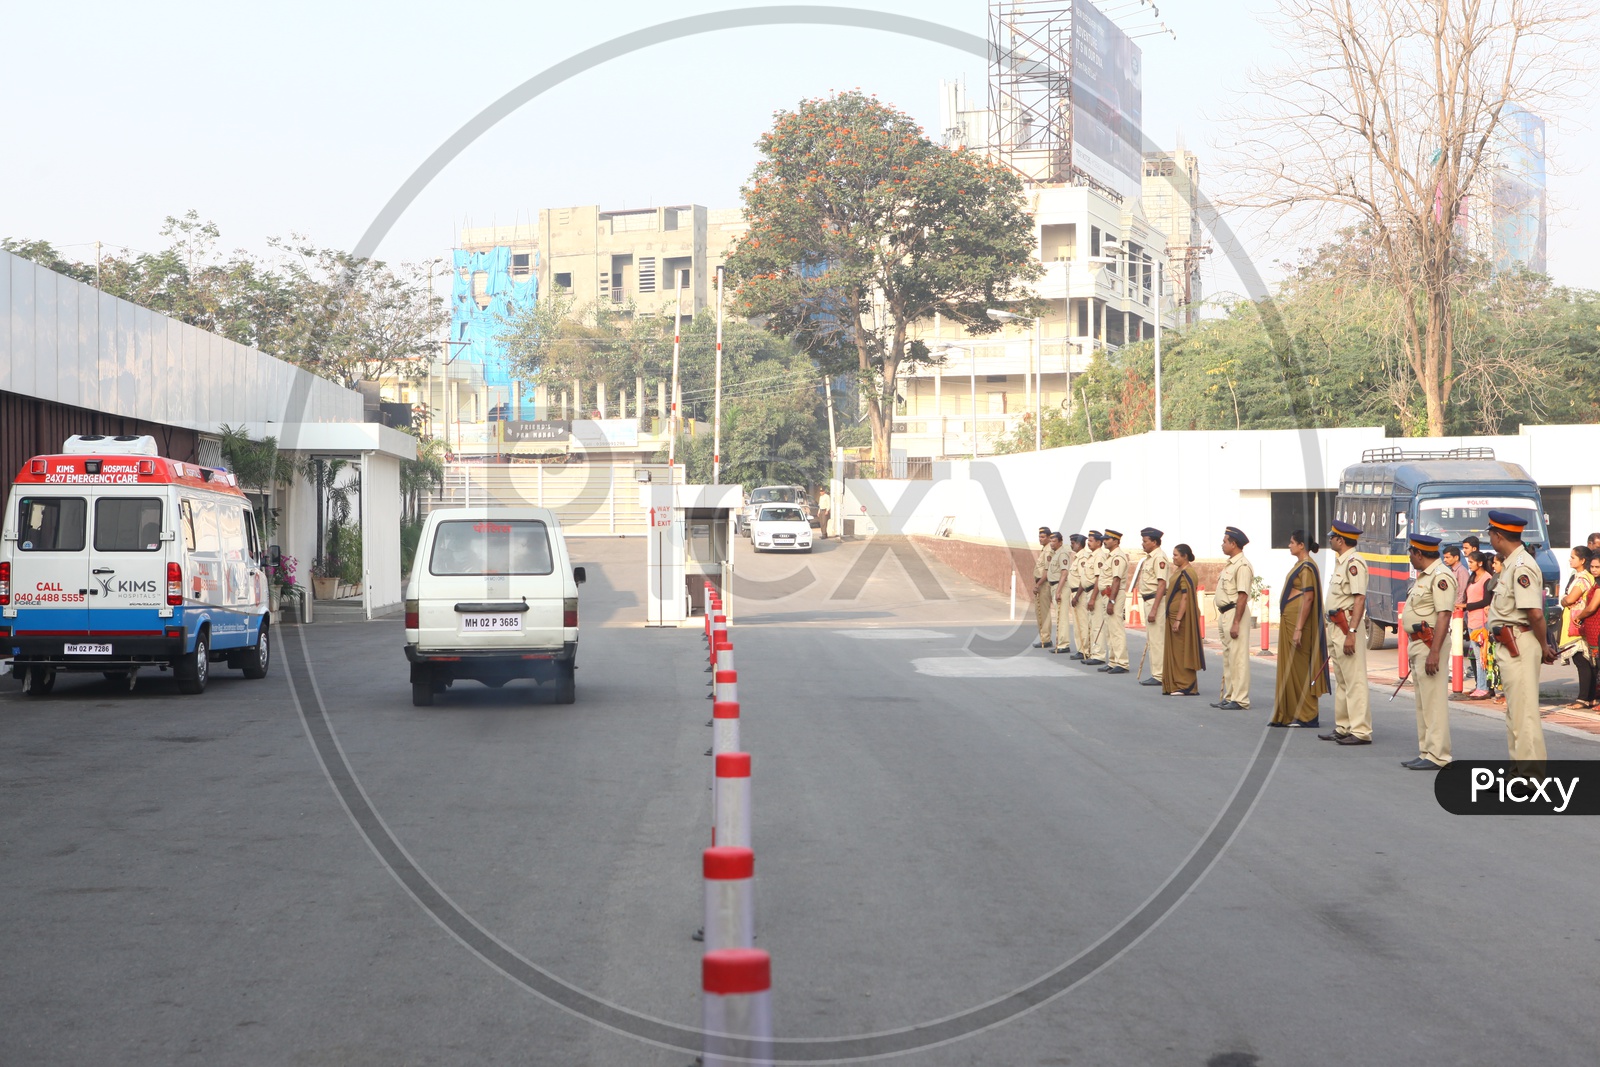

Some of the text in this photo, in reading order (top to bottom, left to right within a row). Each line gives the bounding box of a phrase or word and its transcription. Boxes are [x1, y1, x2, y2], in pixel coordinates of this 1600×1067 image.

[56, 465, 138, 473] KIMS HOSPITALS
[45, 474, 138, 483] 24X7 EMERGENCY CARE
[36, 582, 63, 591] CALL
[118, 580, 156, 592] KIMS
[14, 593, 84, 602] 040 4488 5555
[465, 618, 519, 627] MH 02 P 3685
